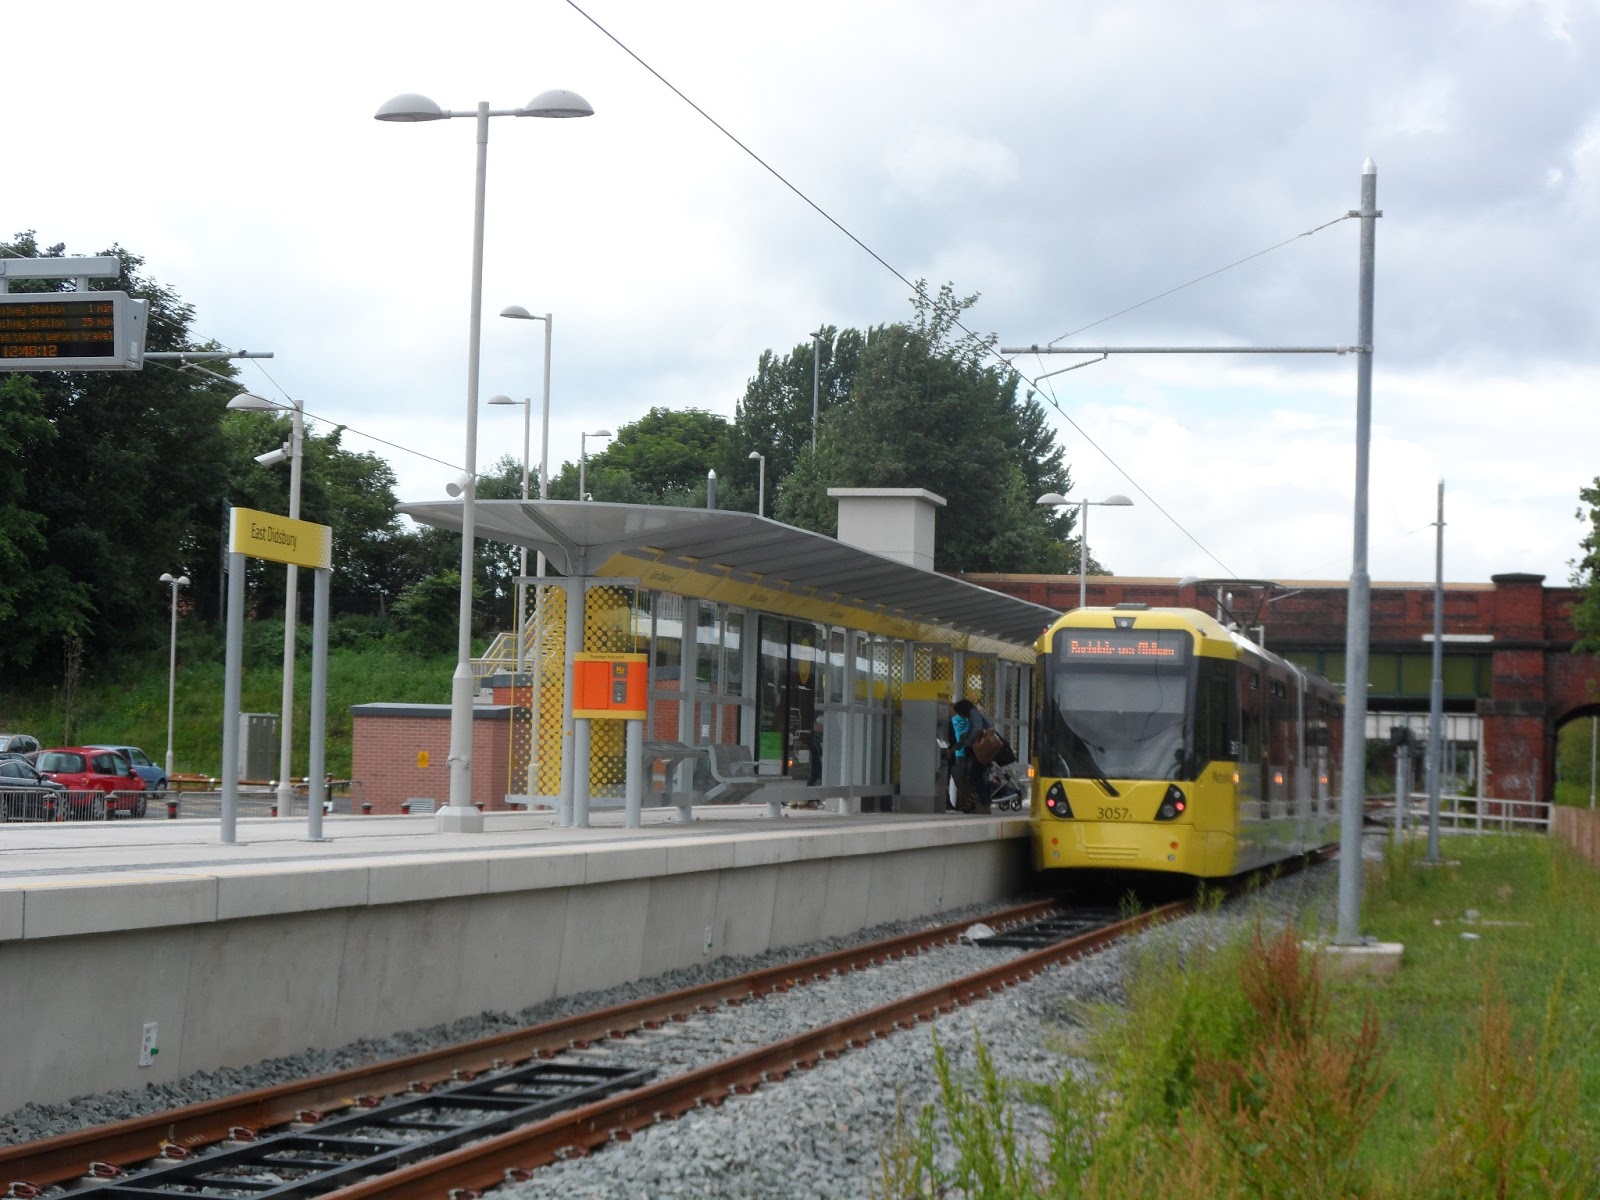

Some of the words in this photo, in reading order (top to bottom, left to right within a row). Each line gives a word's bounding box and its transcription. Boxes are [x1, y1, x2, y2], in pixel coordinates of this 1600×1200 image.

[30, 304, 65, 315] Station
[88, 303, 94, 313] 1
[96, 304, 113, 313] min
[30, 318, 65, 328] Station
[82, 317, 94, 327] 25
[96, 317, 113, 327] min
[3, 344, 58, 358] 12:48:12
[251, 522, 267, 541] East
[267, 526, 298, 552] Didsbury
